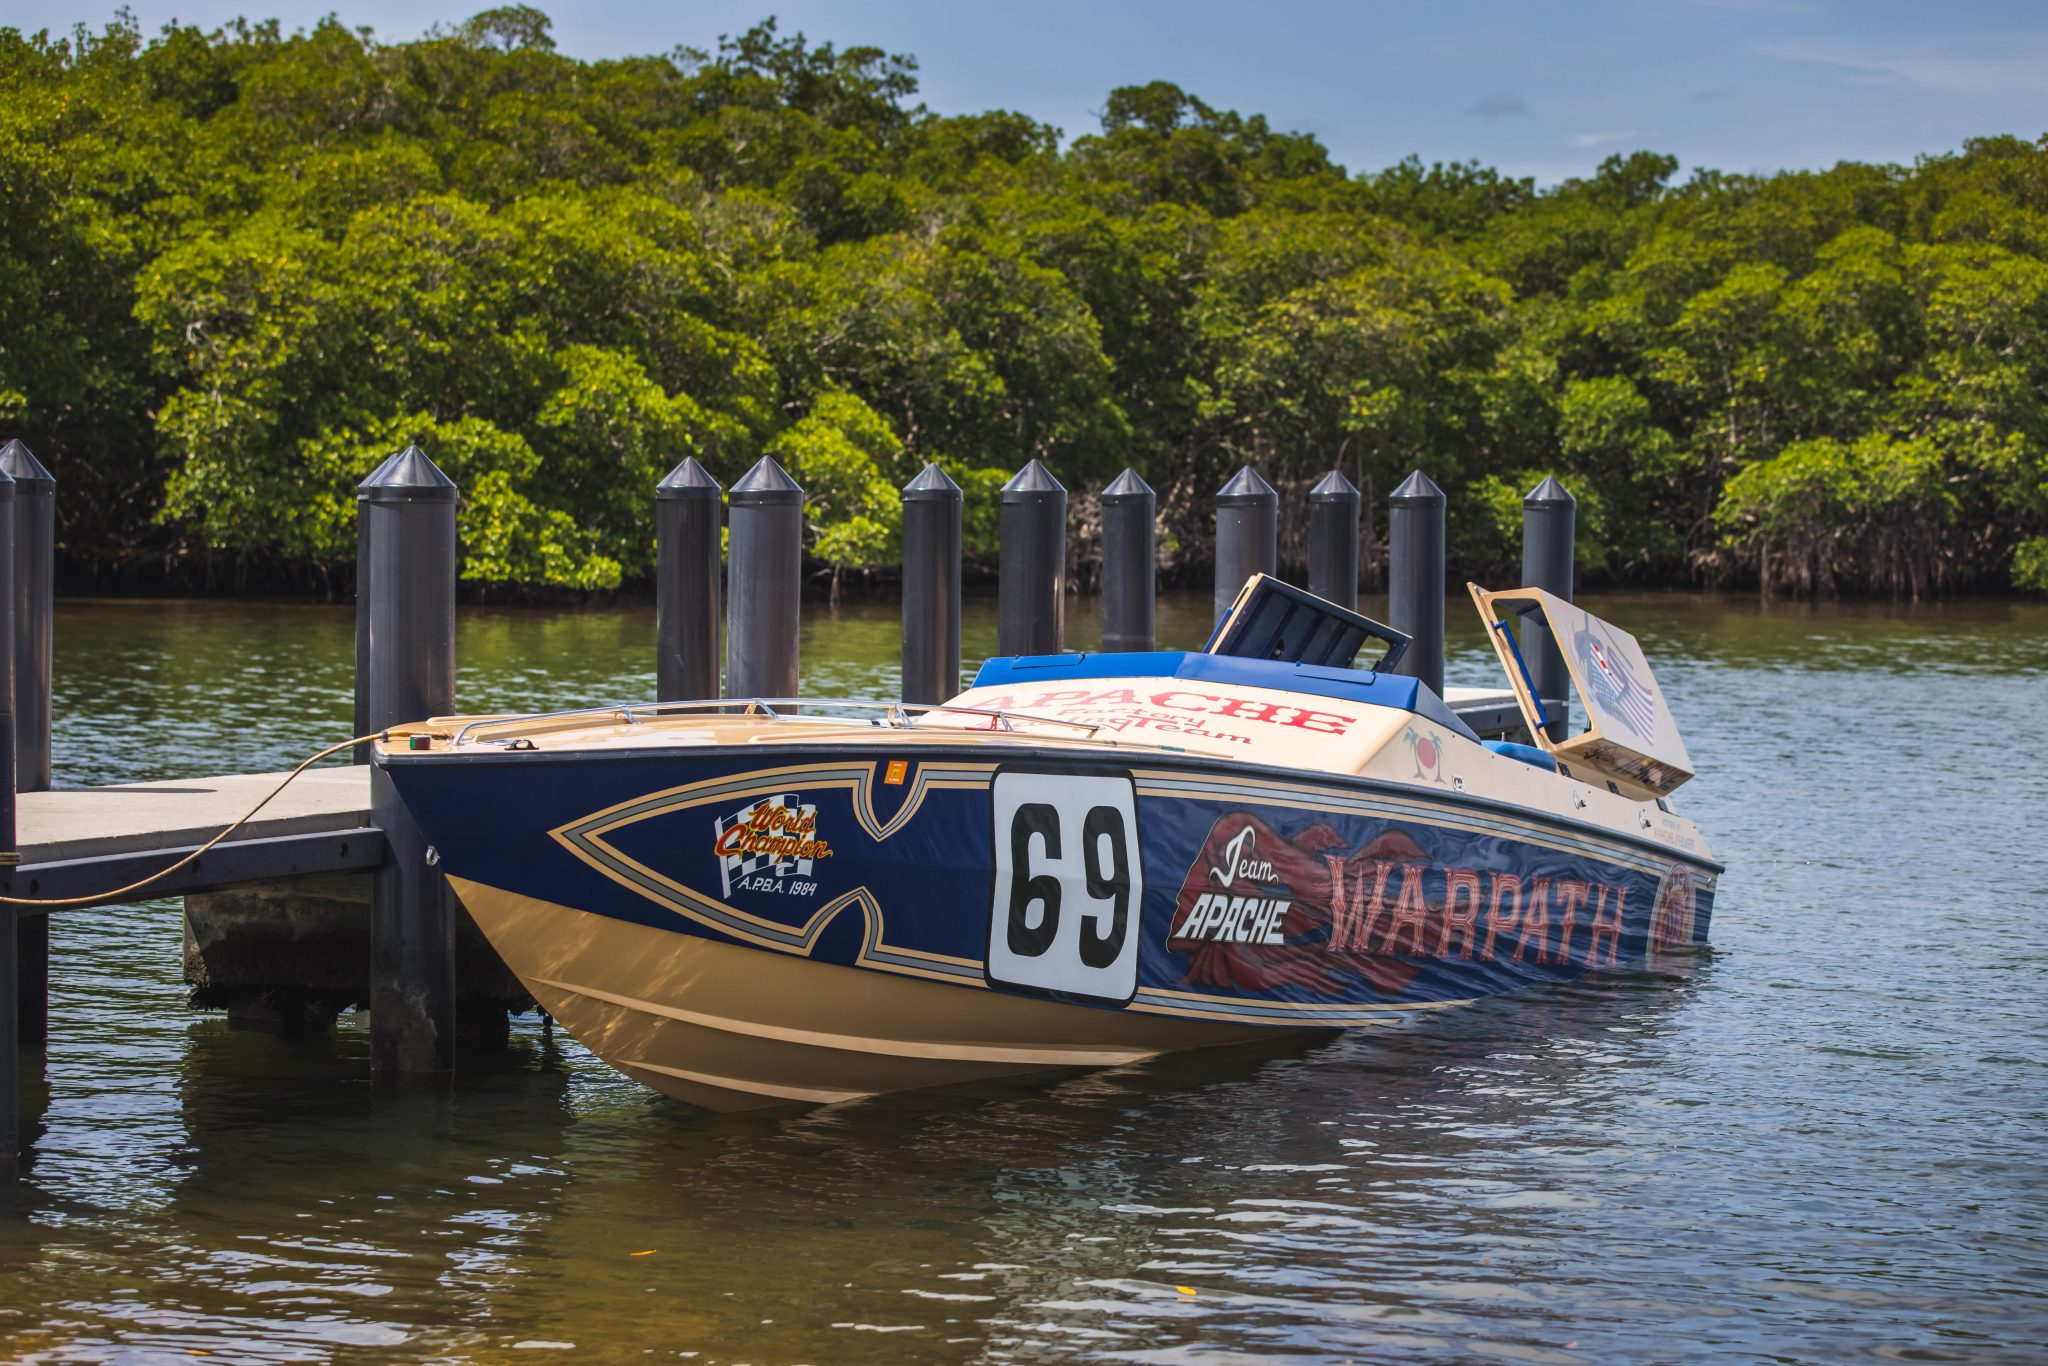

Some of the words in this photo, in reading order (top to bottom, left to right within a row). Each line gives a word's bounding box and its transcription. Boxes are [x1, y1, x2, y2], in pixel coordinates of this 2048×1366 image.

[943, 689, 1356, 735] APACHE
[1057, 707, 1206, 728] Factory
[1127, 714, 1252, 744] Team
[748, 800, 818, 834] World
[714, 823, 833, 864] Champion
[1209, 825, 1278, 887] Team
[788, 880, 817, 896] 1984
[1007, 803, 1130, 968] 69
[1174, 893, 1291, 945] APACHE
[1323, 853, 1630, 967] WARPATH
